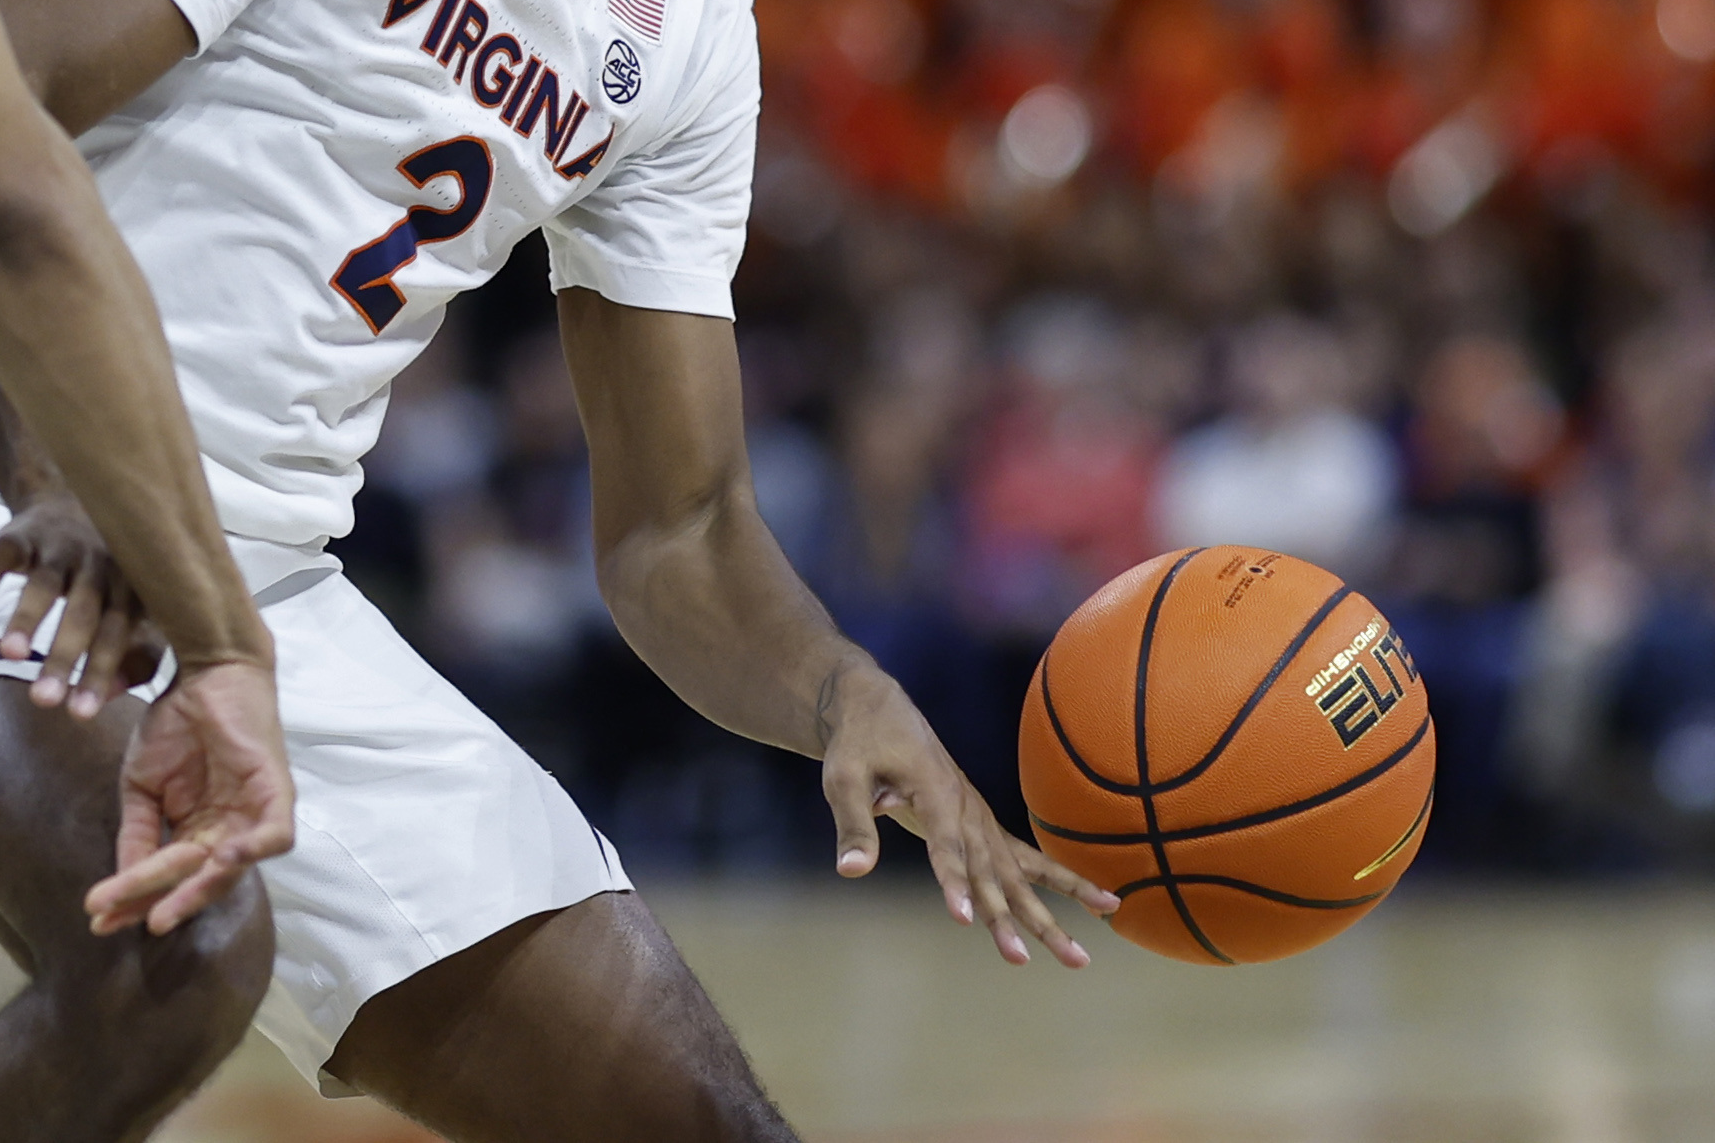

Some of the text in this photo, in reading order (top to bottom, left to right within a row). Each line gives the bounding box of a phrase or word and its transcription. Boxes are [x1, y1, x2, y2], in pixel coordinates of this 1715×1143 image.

[608, 58, 641, 85] ACC
[329, 135, 494, 336] 2
[1305, 614, 1383, 696] MPIONSHIP
[1315, 626, 1420, 751] ELITE
